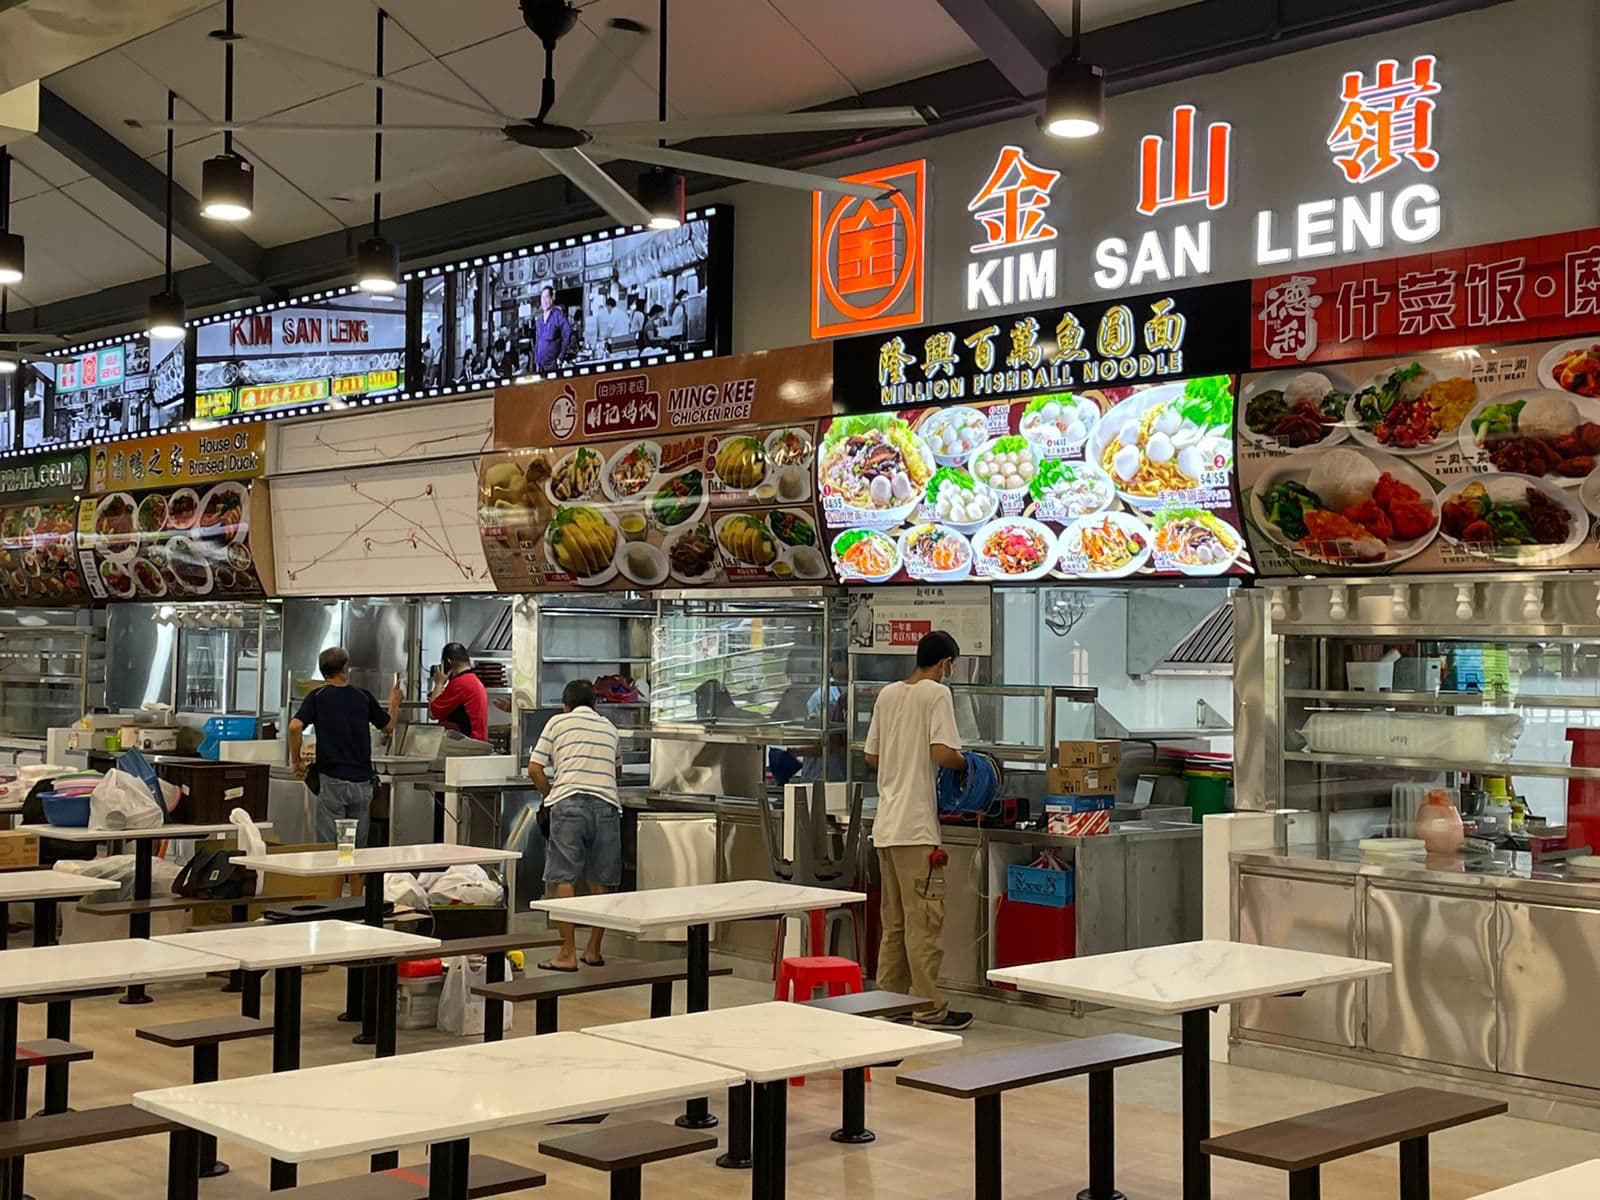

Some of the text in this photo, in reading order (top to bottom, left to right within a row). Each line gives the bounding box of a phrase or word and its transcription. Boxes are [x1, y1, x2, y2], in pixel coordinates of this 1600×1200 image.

[965, 183, 1442, 310] KIM SAN LENG
[229, 315, 369, 347] KIM SAN LENG
[880, 350, 1184, 406] MILLION FISHBALL NOODLE
[1479, 375, 1494, 383] VEG
[1504, 372, 1526, 381] MEAT
[667, 379, 756, 412] MING KEE
[671, 403, 751, 426] CHICKEN RICE
[199, 431, 249, 455] House Of
[189, 452, 257, 476] Braised Duck
[1443, 465, 1463, 474] MEAT
